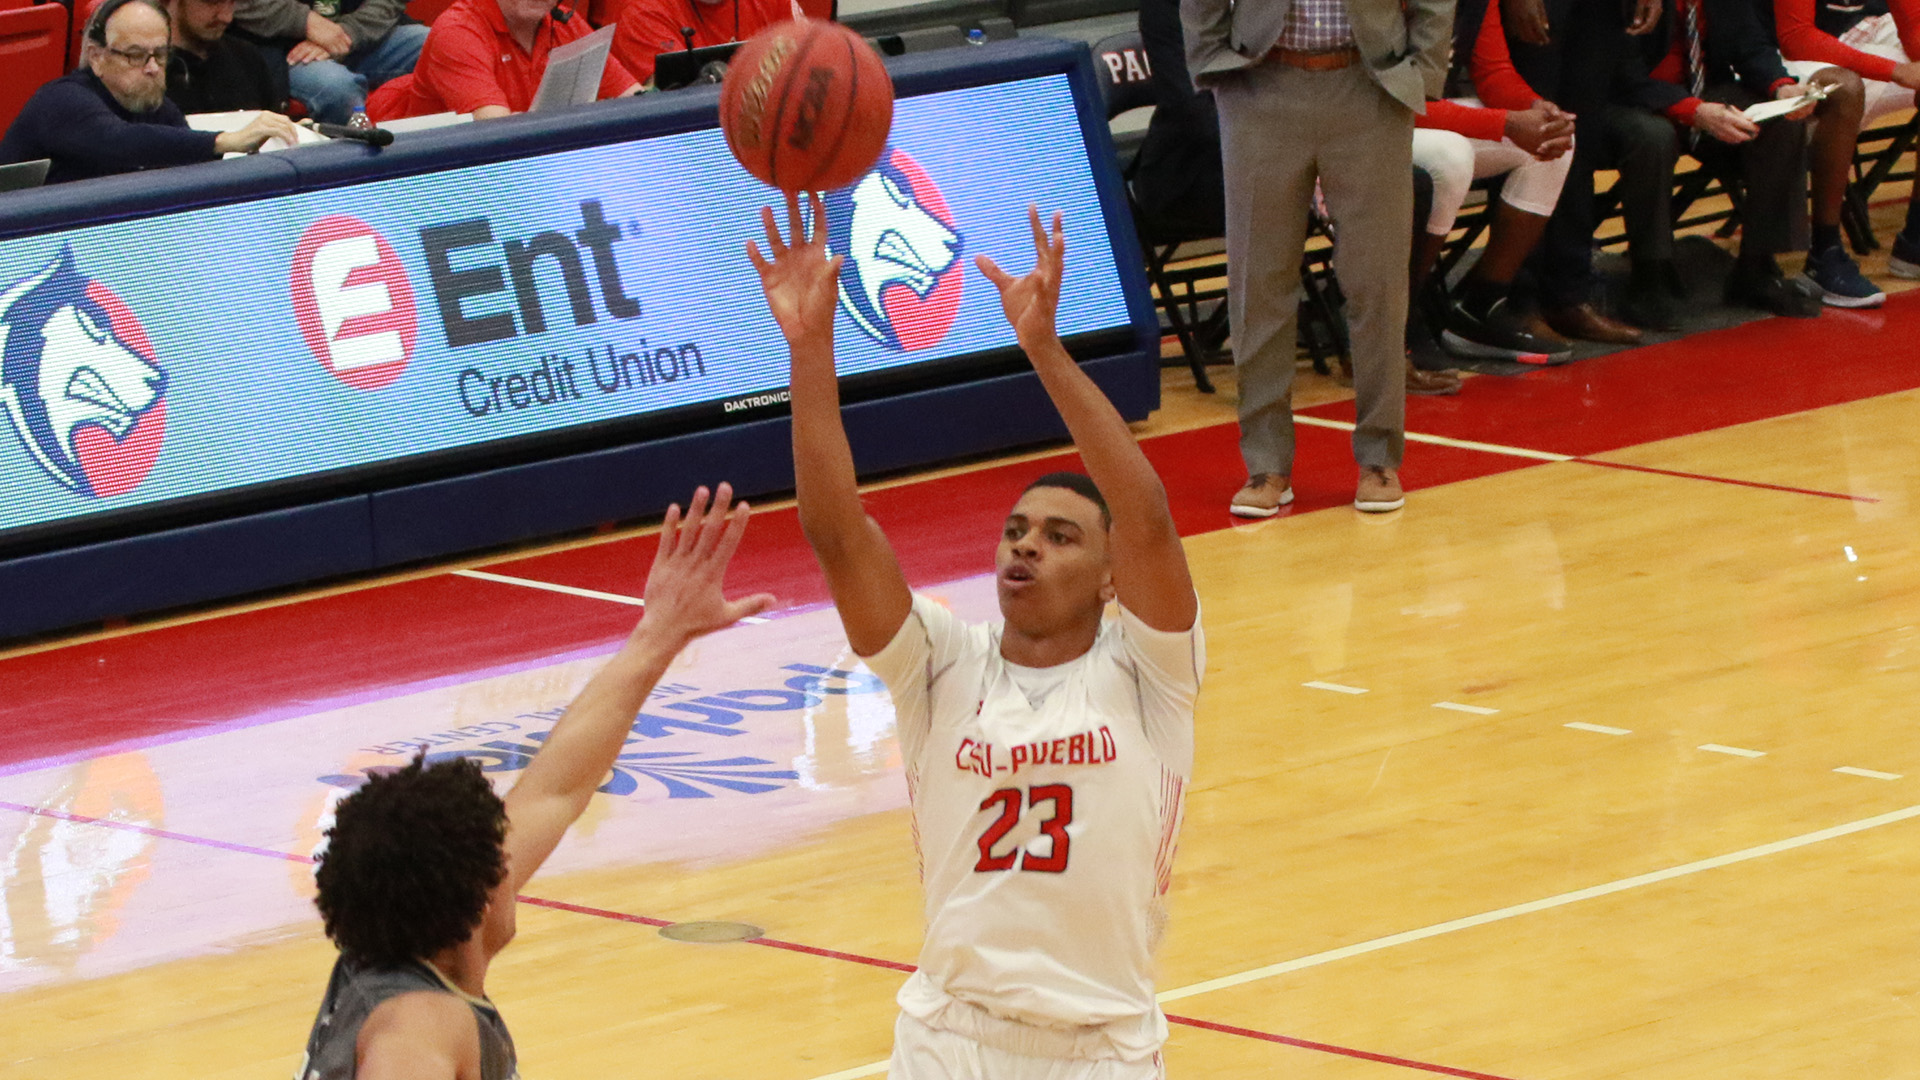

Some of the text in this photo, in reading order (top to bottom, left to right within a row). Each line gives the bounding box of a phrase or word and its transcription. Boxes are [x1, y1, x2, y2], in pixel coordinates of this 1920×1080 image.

[1101, 48, 1152, 85] PA
[420, 200, 643, 348] Ent
[456, 338, 706, 418] Credit Union
[359, 682, 701, 756] MEAL CENTER
[973, 783, 1073, 875] 23
